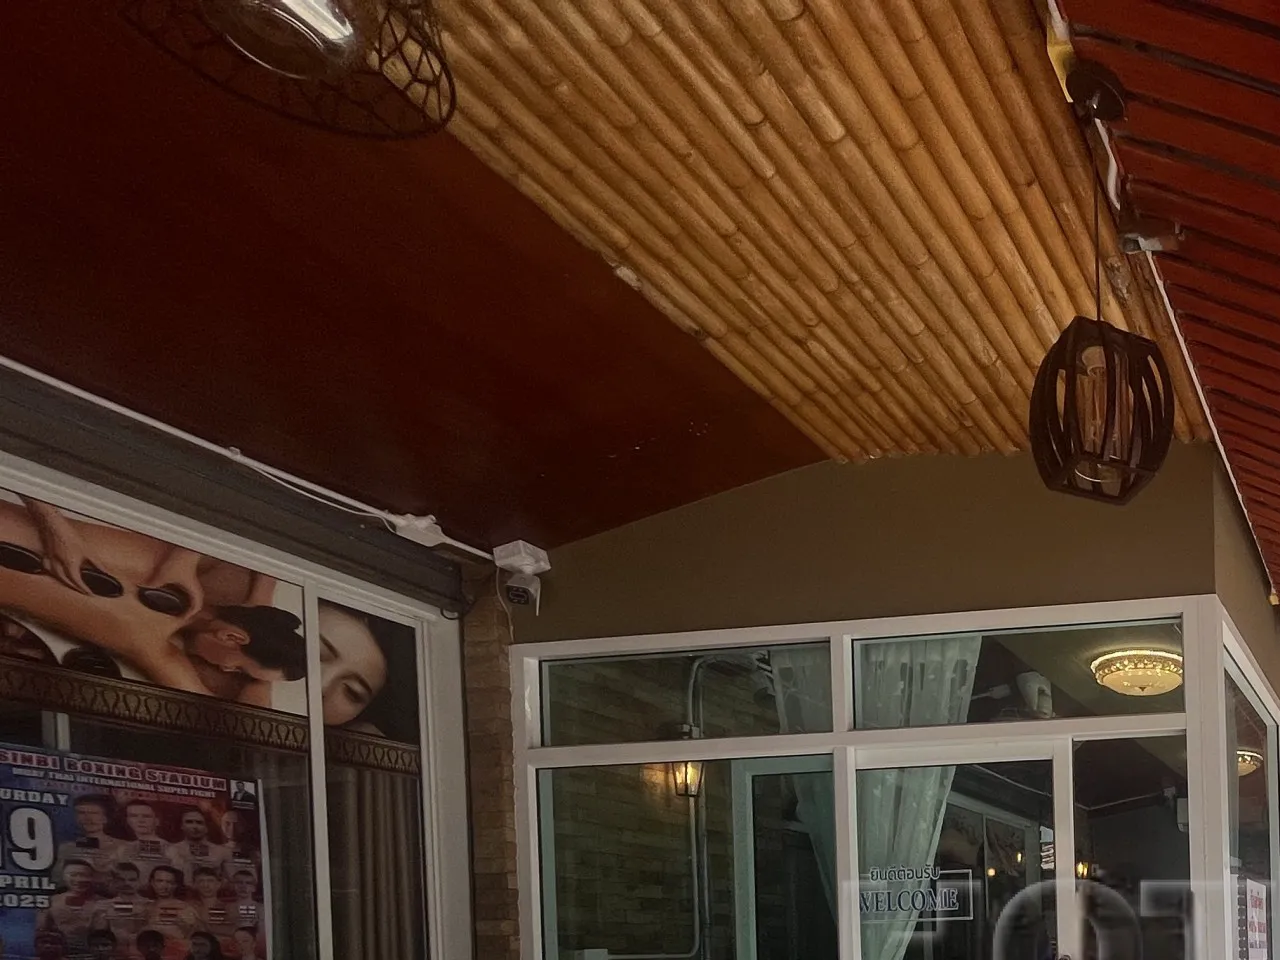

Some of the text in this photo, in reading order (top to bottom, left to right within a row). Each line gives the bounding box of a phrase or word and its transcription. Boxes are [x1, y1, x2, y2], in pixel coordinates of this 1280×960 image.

[63, 757, 143, 781] BOXING
[145, 768, 227, 791] STADIUM
[869, 864, 941, 882] ยินดีต้อนรับ
[0, 893, 50, 908] 025
